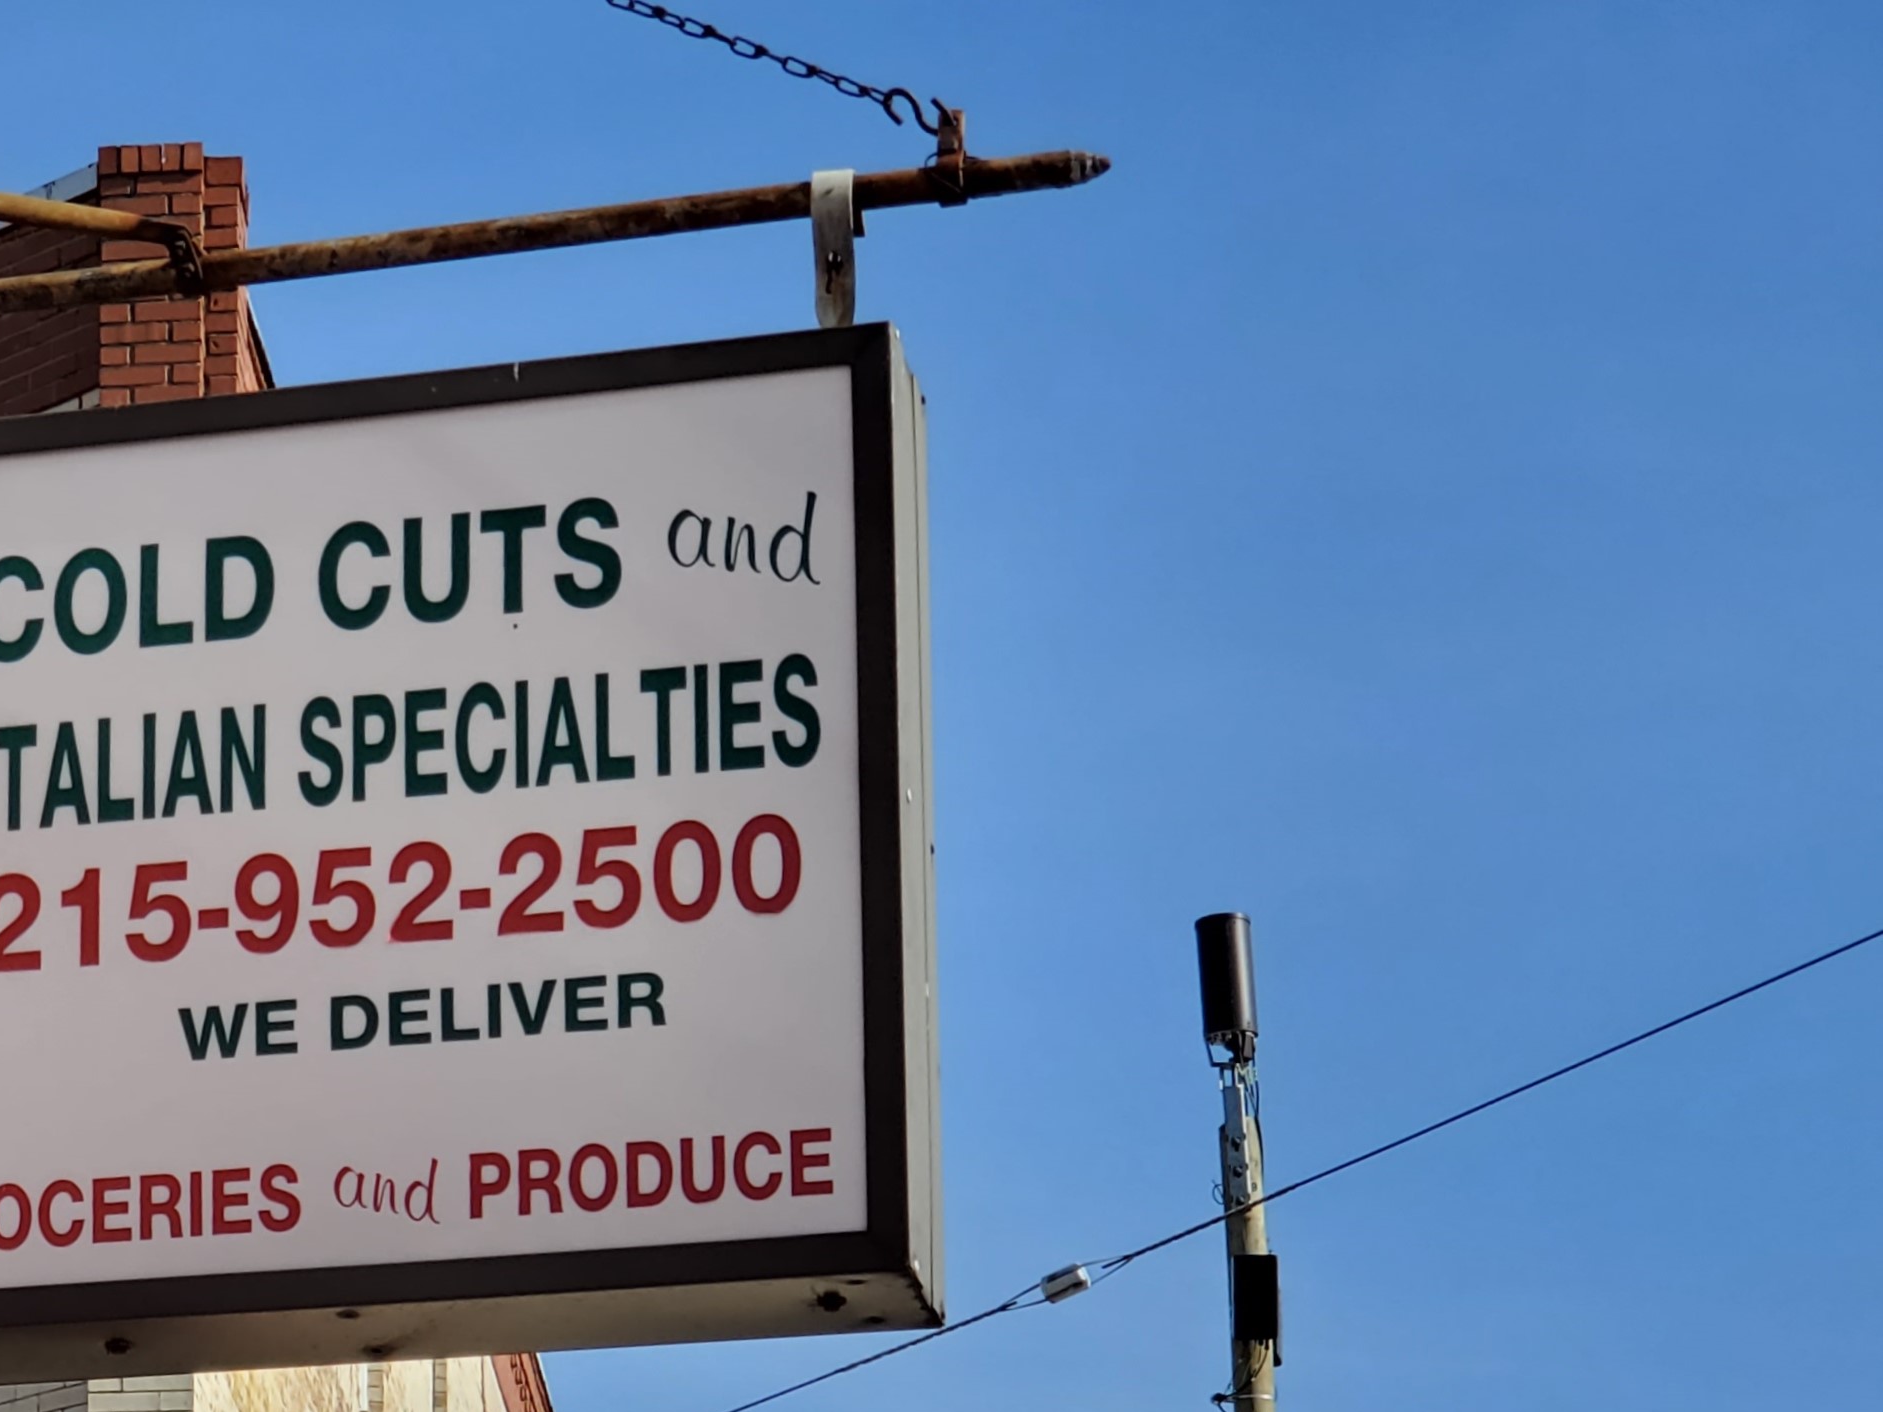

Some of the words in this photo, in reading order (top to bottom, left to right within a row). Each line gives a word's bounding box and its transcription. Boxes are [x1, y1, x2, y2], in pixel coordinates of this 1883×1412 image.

[317, 497, 622, 631] CUTS
[667, 490, 822, 585] and
[297, 653, 822, 808] SPECIALTIES
[178, 999, 299, 1060] WE
[329, 972, 667, 1051] DELIVER
[334, 1158, 440, 1225] and
[468, 1128, 835, 1220] PRODUCE
